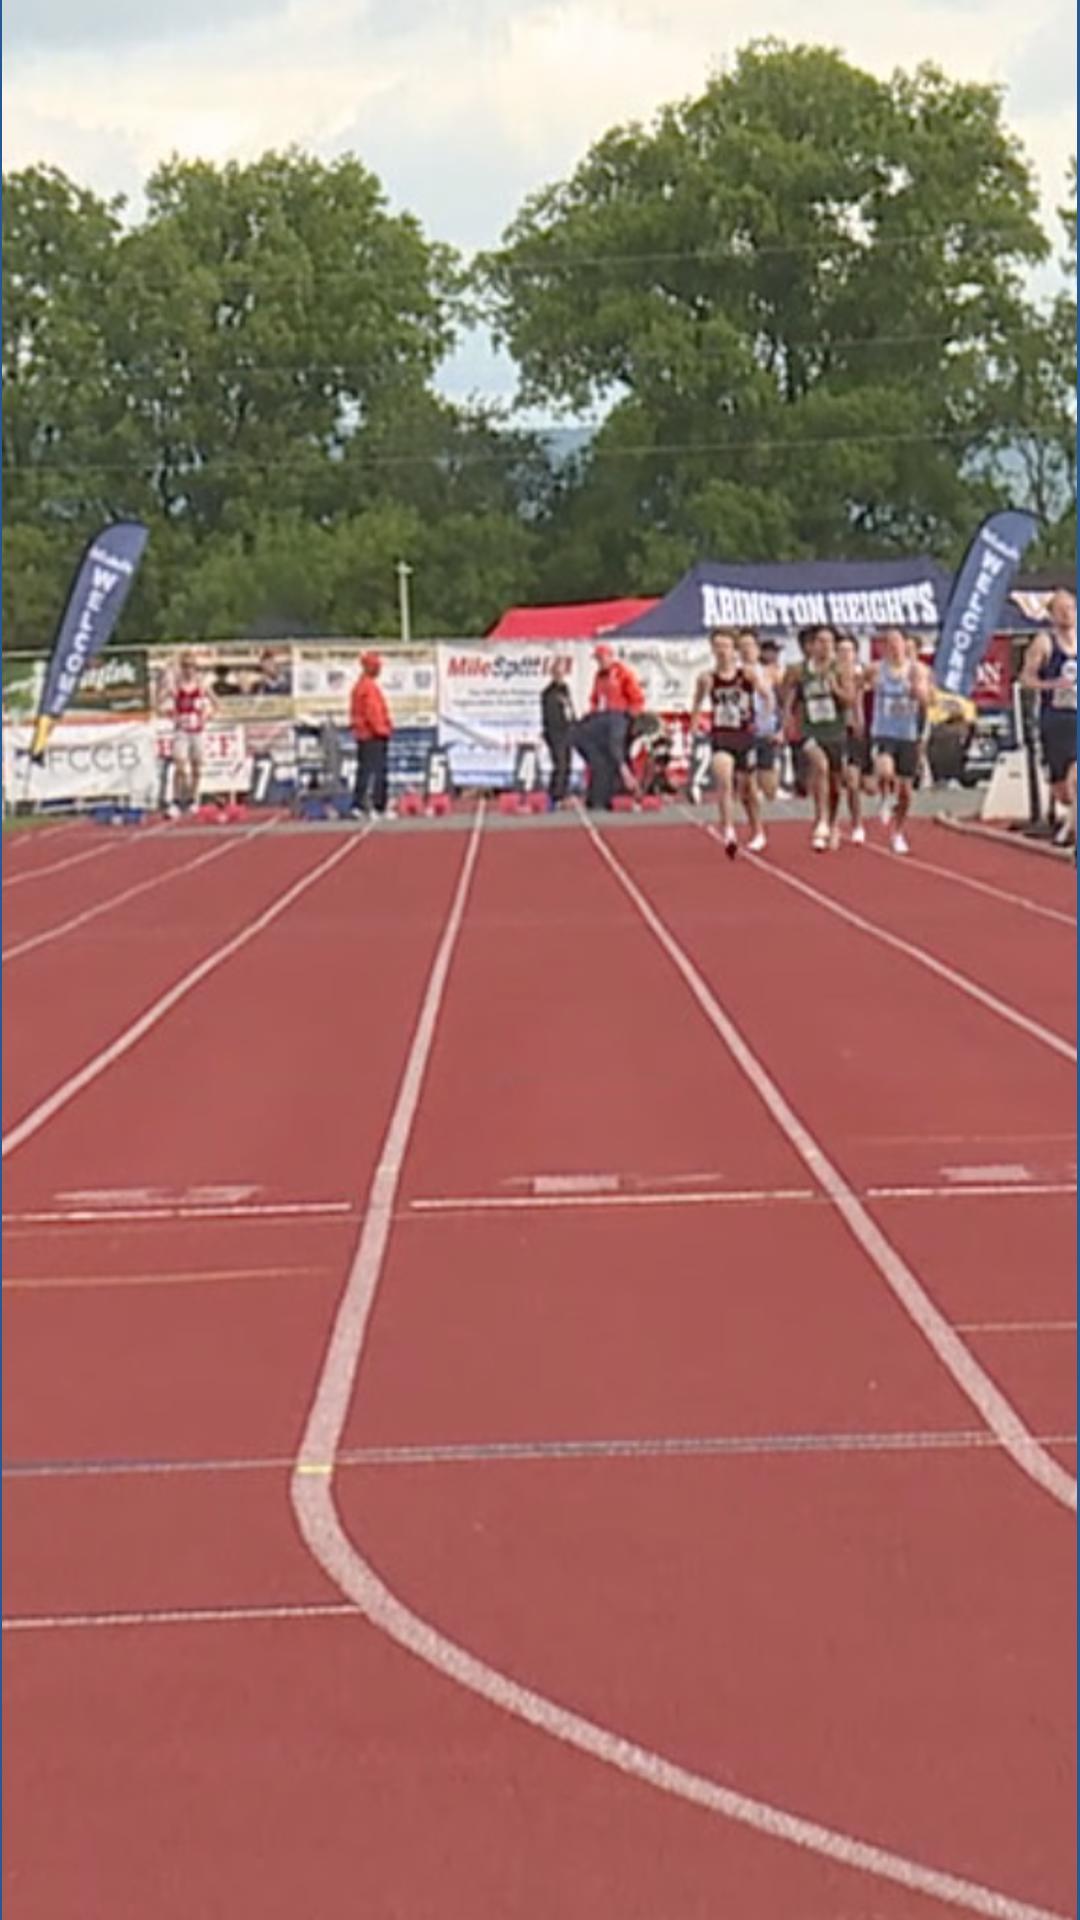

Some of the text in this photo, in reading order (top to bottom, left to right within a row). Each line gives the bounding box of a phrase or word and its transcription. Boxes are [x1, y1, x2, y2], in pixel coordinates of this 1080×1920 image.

[701, 580, 939, 628] ABINGTON HEIGHTS
[945, 550, 1004, 692] WELCOME
[50, 566, 119, 714] WELCOME
[251, 759, 273, 800] 7
[430, 753, 448, 794] 5
[516, 750, 536, 791] 4
